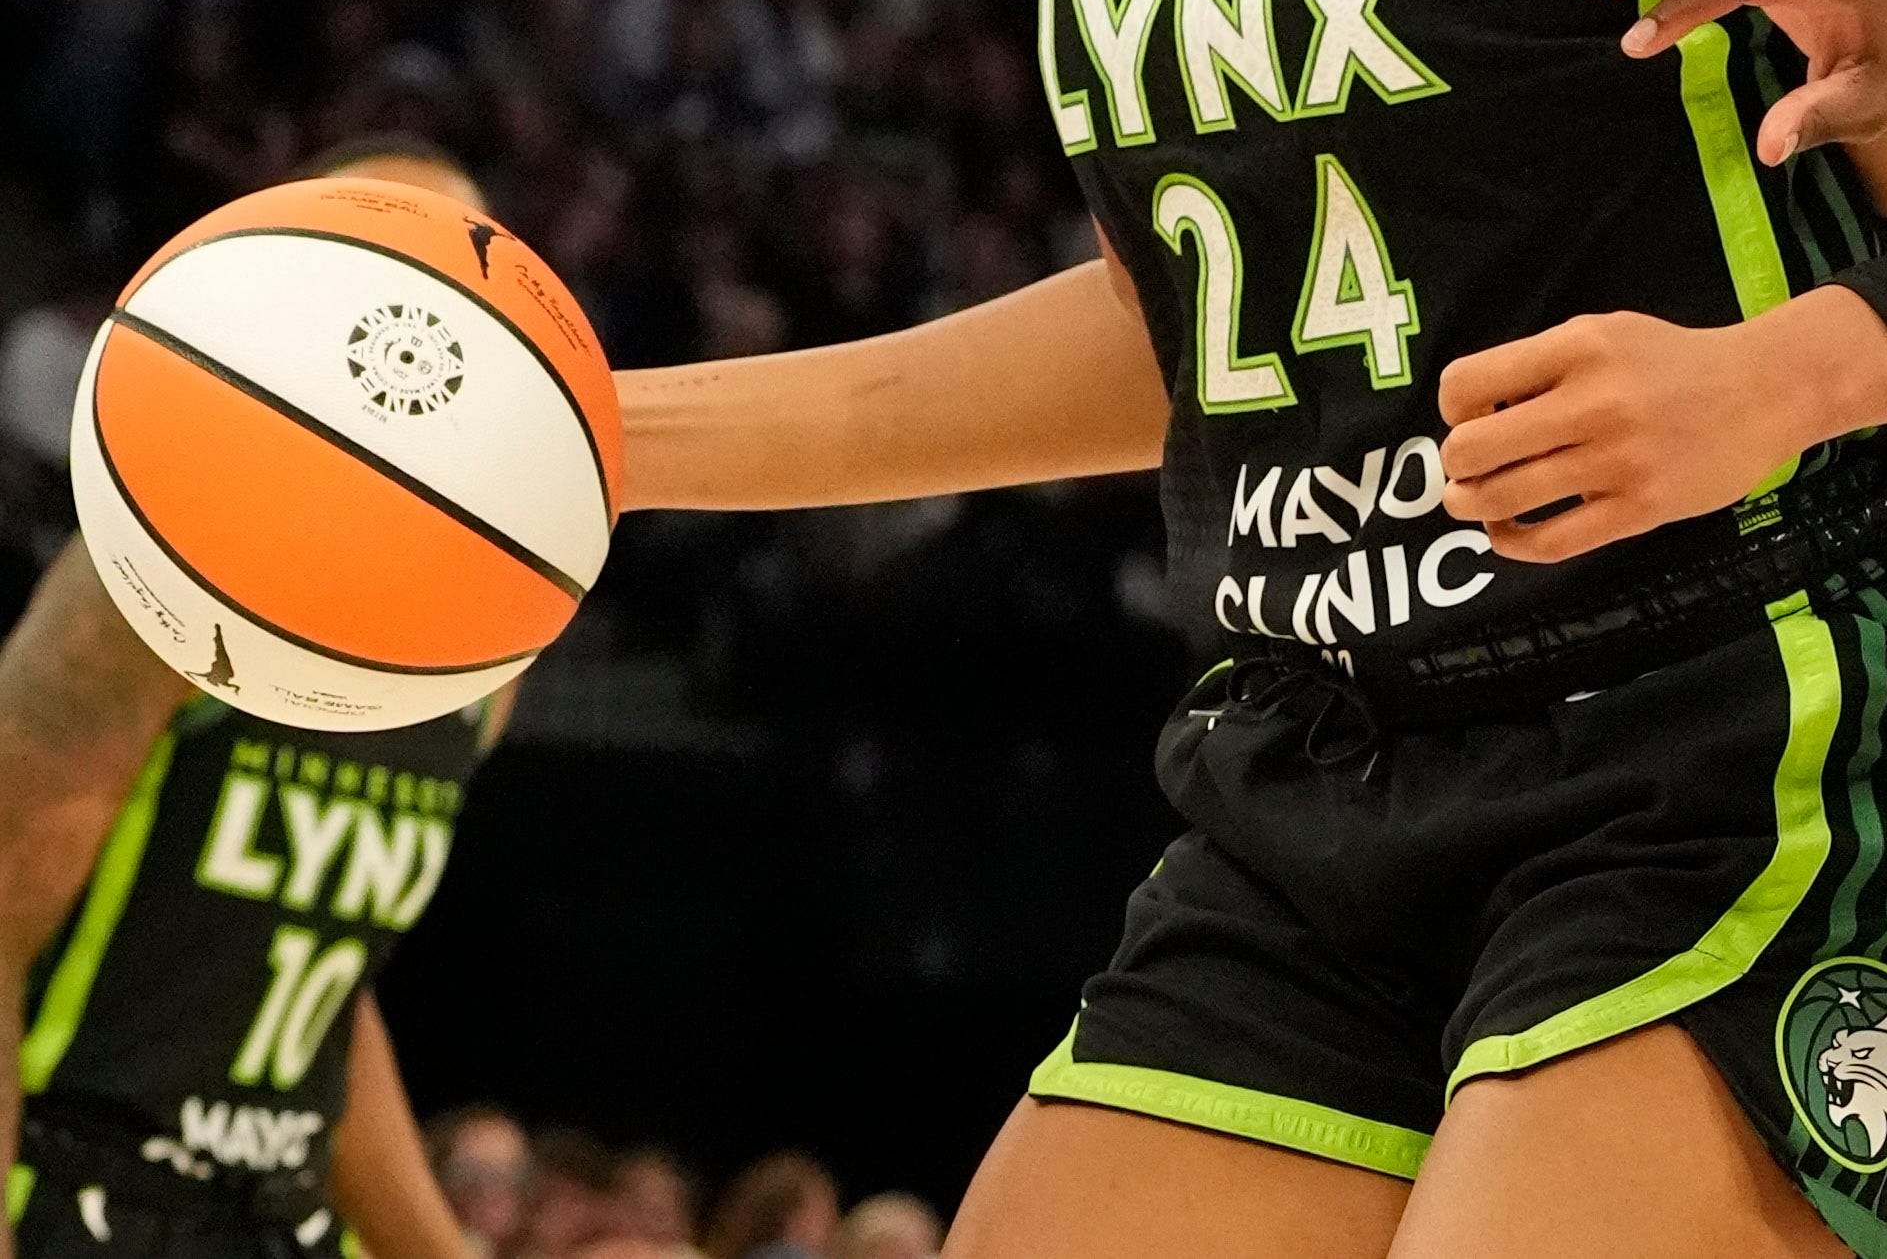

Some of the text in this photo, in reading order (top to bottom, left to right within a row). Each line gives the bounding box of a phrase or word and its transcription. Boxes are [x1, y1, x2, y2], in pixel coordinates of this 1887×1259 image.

[1152, 153, 1421, 415] 24
[1227, 436, 1445, 548] MAYO
[1214, 529, 1496, 644] CLINIC
[229, 925, 368, 1091] 10
